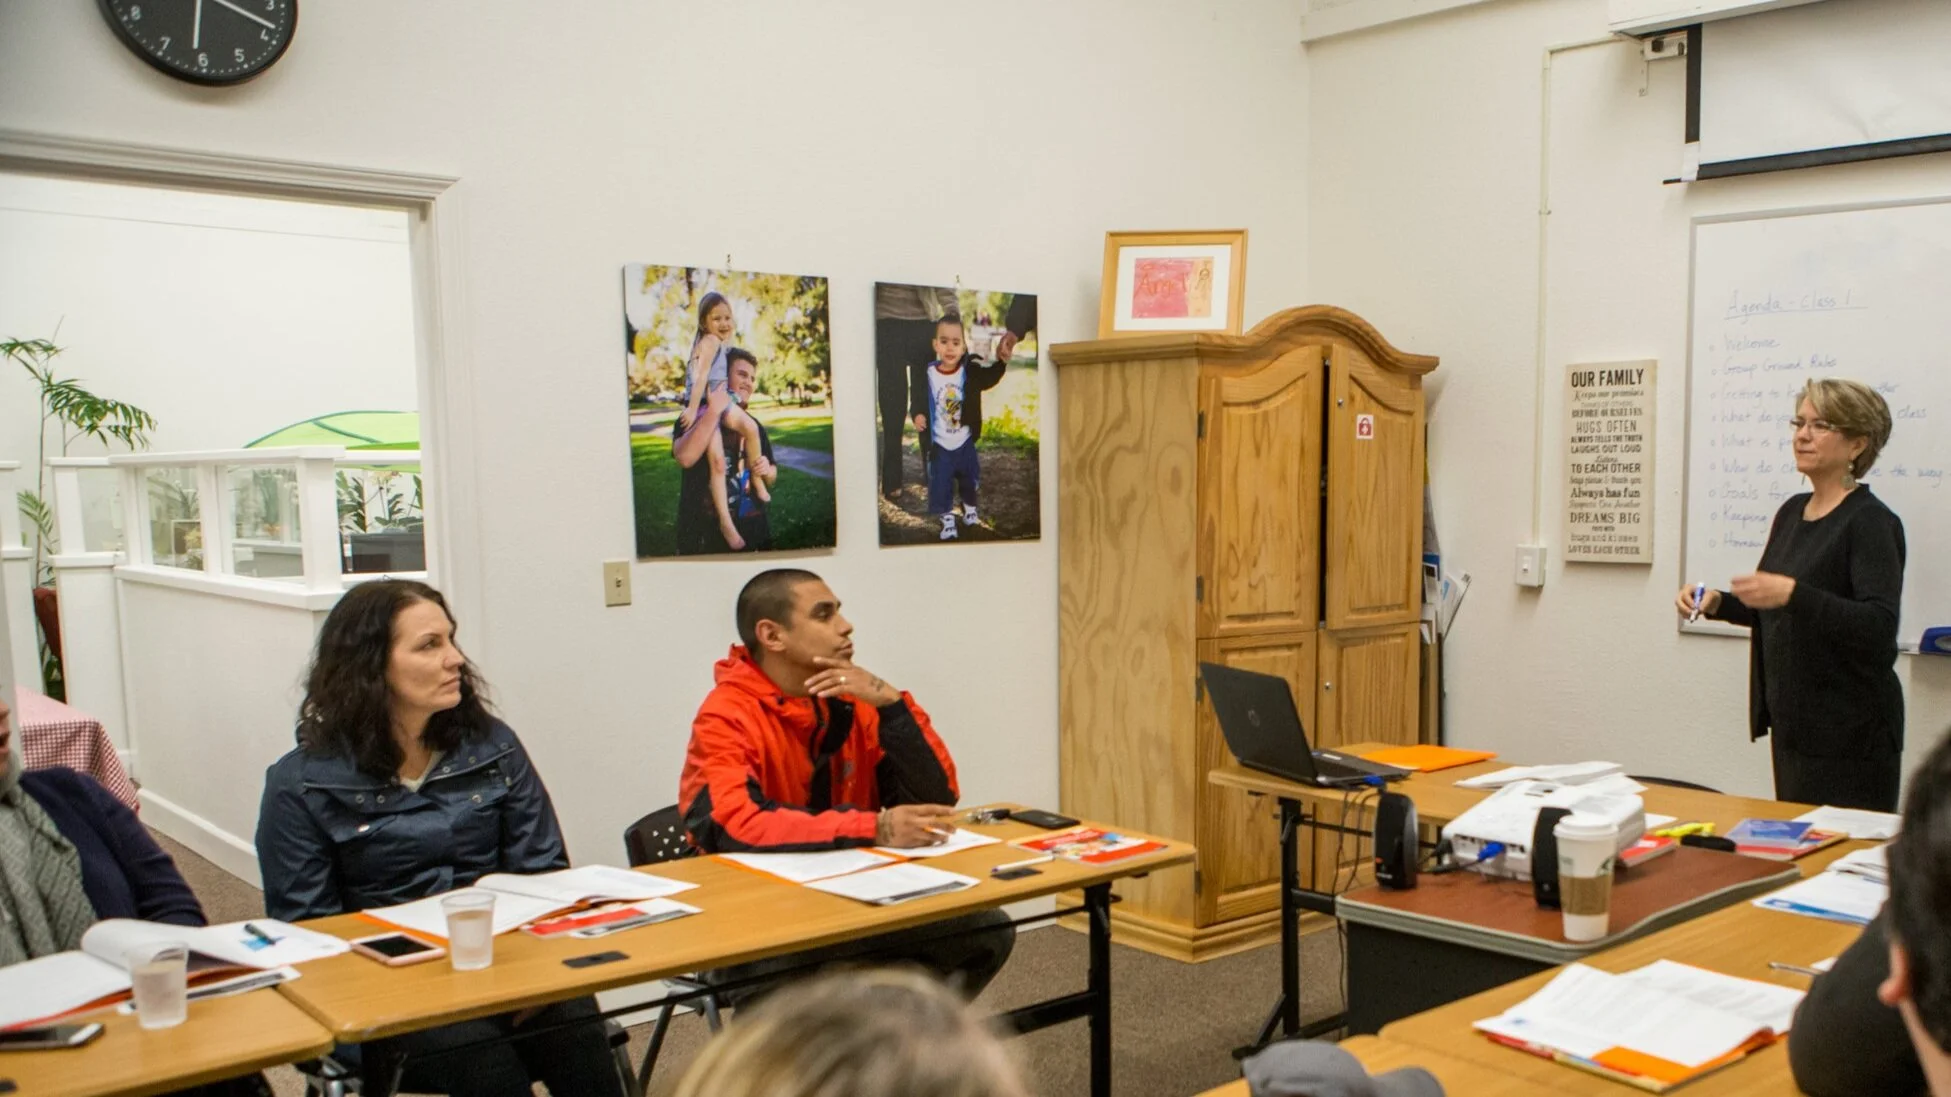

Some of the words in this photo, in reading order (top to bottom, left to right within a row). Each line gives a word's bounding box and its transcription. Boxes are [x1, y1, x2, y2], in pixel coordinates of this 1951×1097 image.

[131, 5, 141, 20] 8
[260, 28, 269, 41] 4
[159, 36, 171, 51] 7
[198, 53, 209, 67] 6
[234, 48, 245, 63] 5
[1727, 289, 1783, 325] Agenda
[1723, 333, 1780, 352] Welcome
[1723, 355, 1758, 379] Group
[1763, 357, 1804, 373] Ground
[1571, 371, 1595, 388] OUR
[1599, 368, 1645, 387] FAMILY
[1576, 420, 1602, 434] HUGS
[1607, 419, 1637, 433] OFTEN
[1571, 435, 1594, 443] ALWAYS
[1613, 434, 1623, 442] THE
[1571, 445, 1600, 454] LAUGHS
[1602, 444, 1618, 453] OUT
[1620, 444, 1642, 453] LOUD
[1571, 463, 1582, 474] TO
[1584, 463, 1608, 474] EACH
[1610, 462, 1641, 473] OTHER
[1917, 467, 1944, 489] way
[1570, 487, 1604, 500] Always
[1605, 487, 1621, 498] has
[1623, 487, 1641, 498] fun
[1569, 511, 1615, 524] DREAMS
[1619, 512, 1641, 524] BIG
